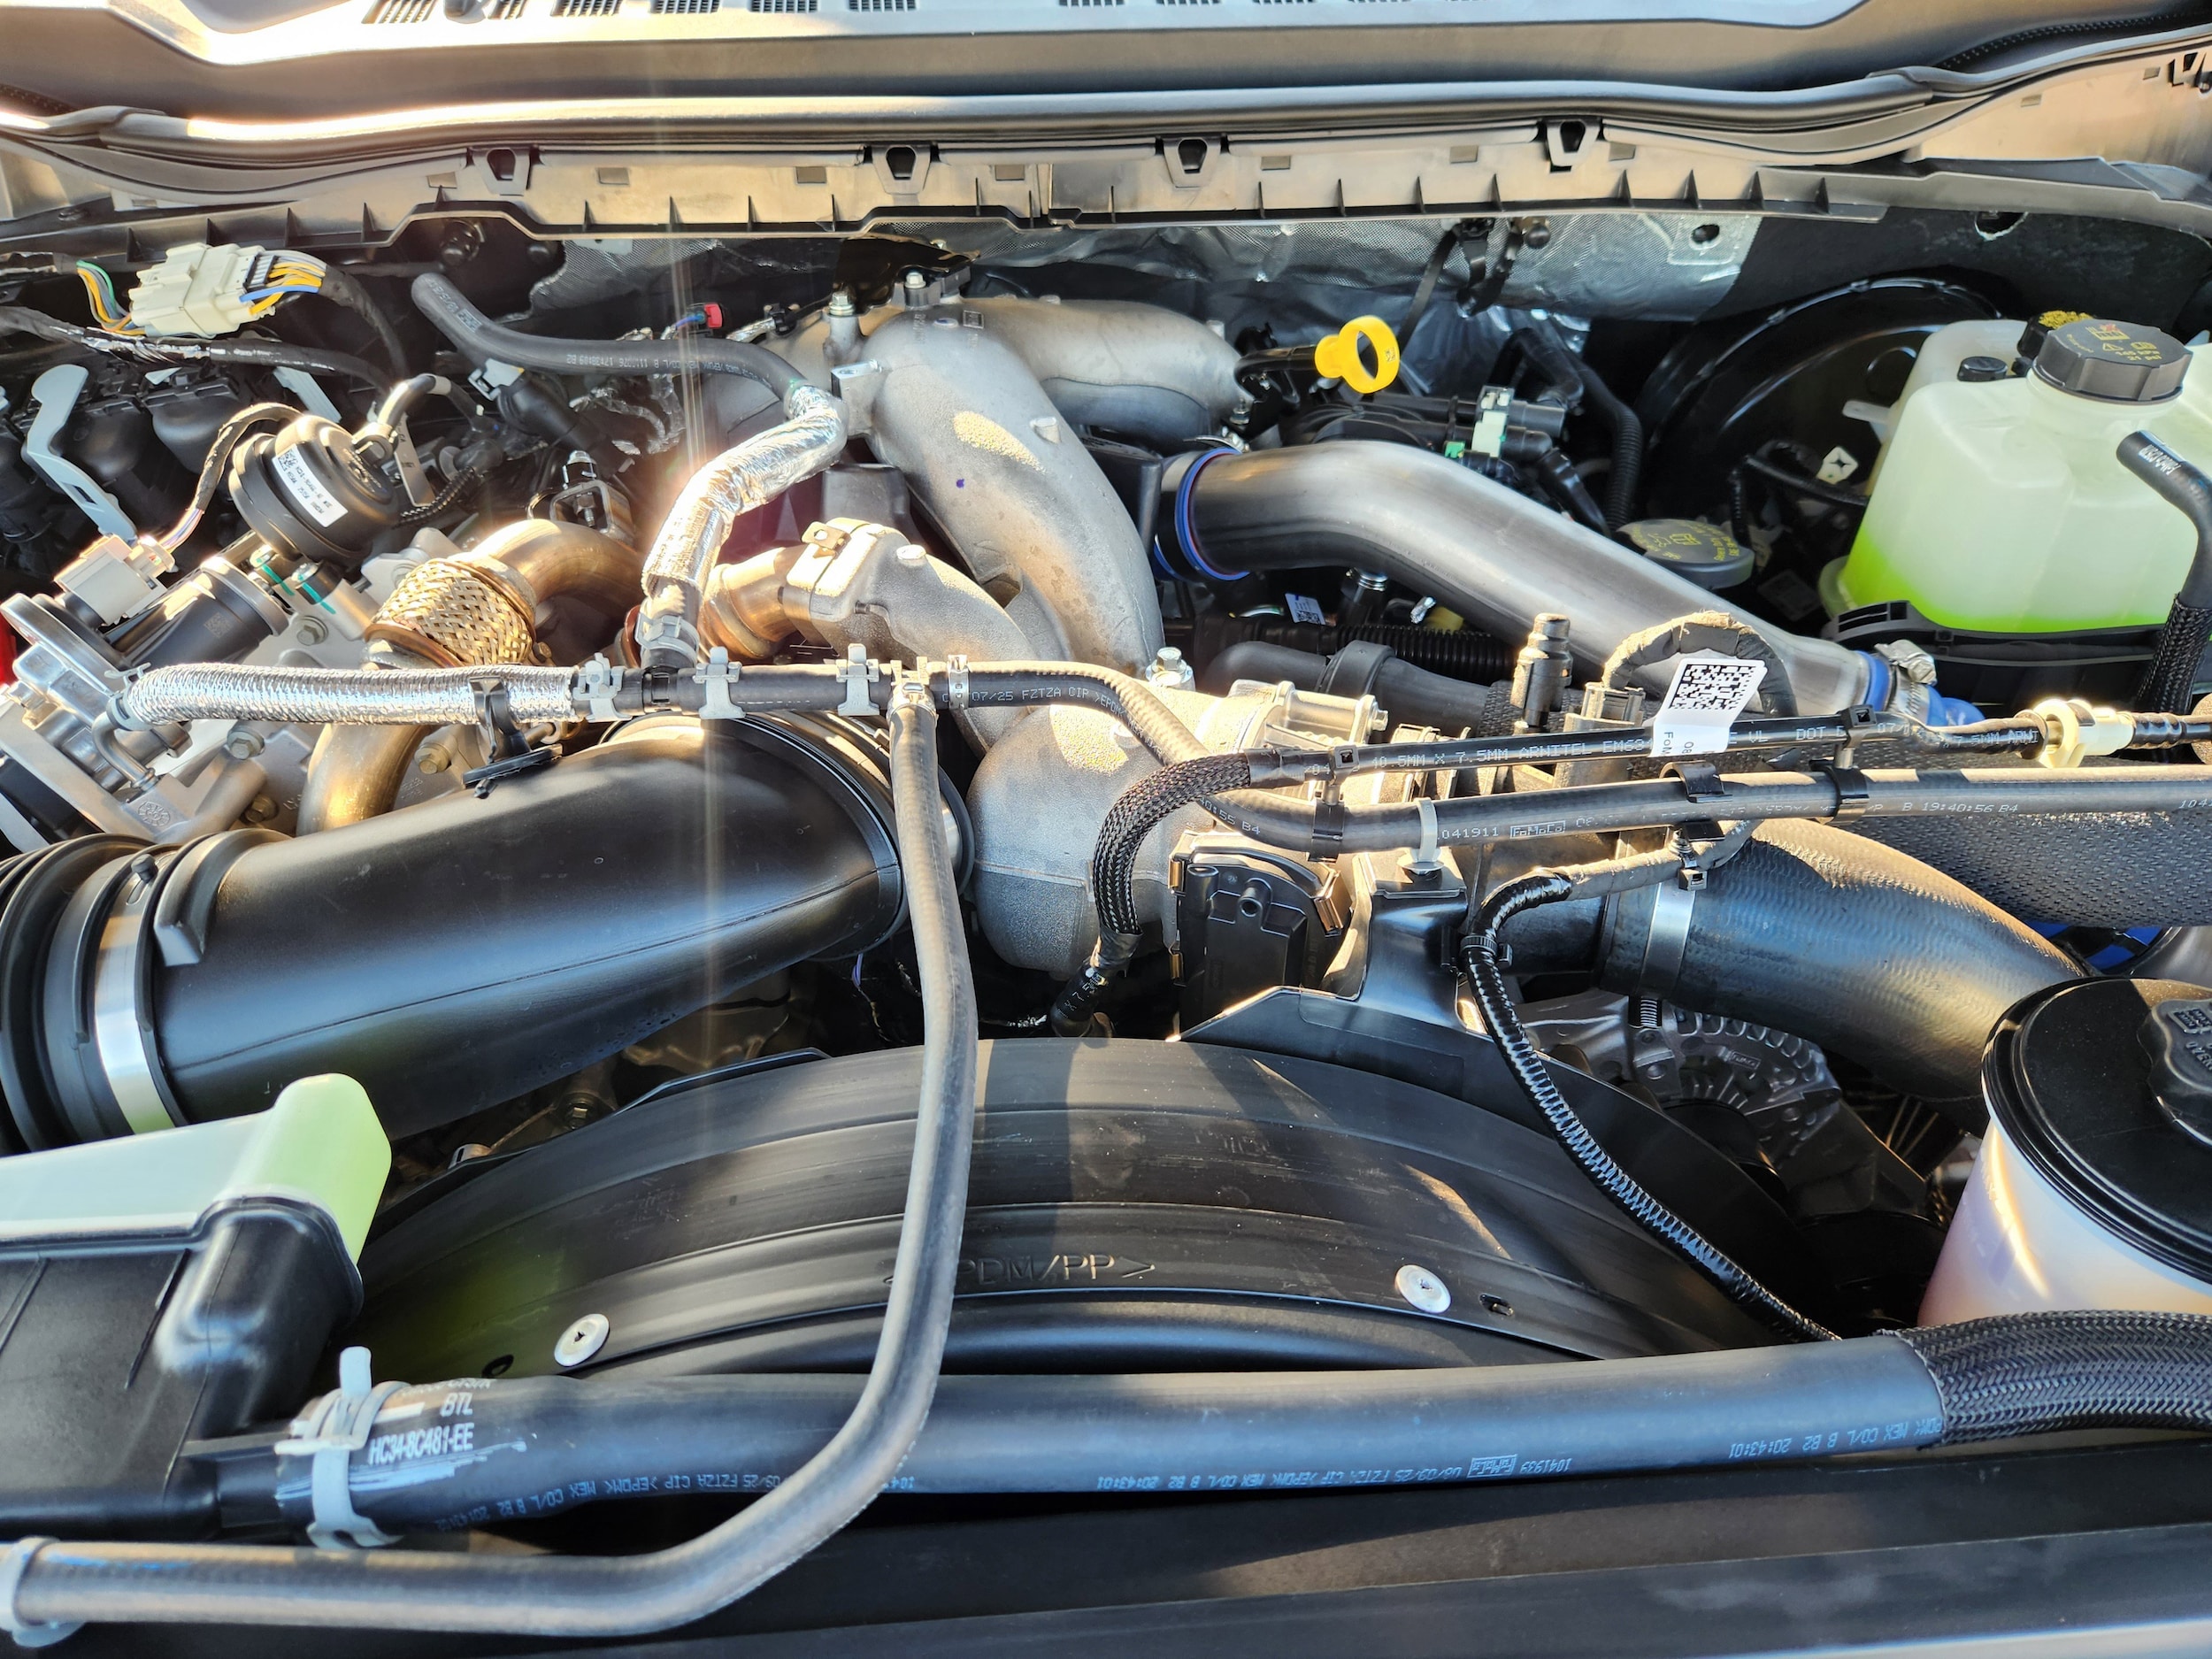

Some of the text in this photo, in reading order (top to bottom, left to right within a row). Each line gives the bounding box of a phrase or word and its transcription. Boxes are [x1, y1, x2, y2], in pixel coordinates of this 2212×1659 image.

[1021, 687, 1062, 700] FZTZA
[1068, 687, 1089, 698] CIP
[1434, 753, 1446, 765] X
[1454, 748, 1509, 764] 7.5MM
[1795, 726, 1827, 741] DOT
[1241, 819, 1261, 835] B4
[1437, 826, 1499, 840] 041911
[1921, 801, 1995, 813] 19:40:56
[1997, 803, 2019, 813] B4
[440, 1392, 474, 1417] BTL
[1801, 1433, 1823, 1452] B2
[1828, 1431, 1839, 1448] B
[1847, 1426, 1879, 1445] CO/L
[1727, 1436, 1793, 1459] 20:43:01
[569, 1479, 595, 1498] MEX
[664, 1474, 692, 1489] CIP
[696, 1472, 739, 1489] FZTZA
[516, 1497, 526, 1514] B
[530, 1487, 564, 1509] CO/L
[496, 1500, 515, 1517] B2
